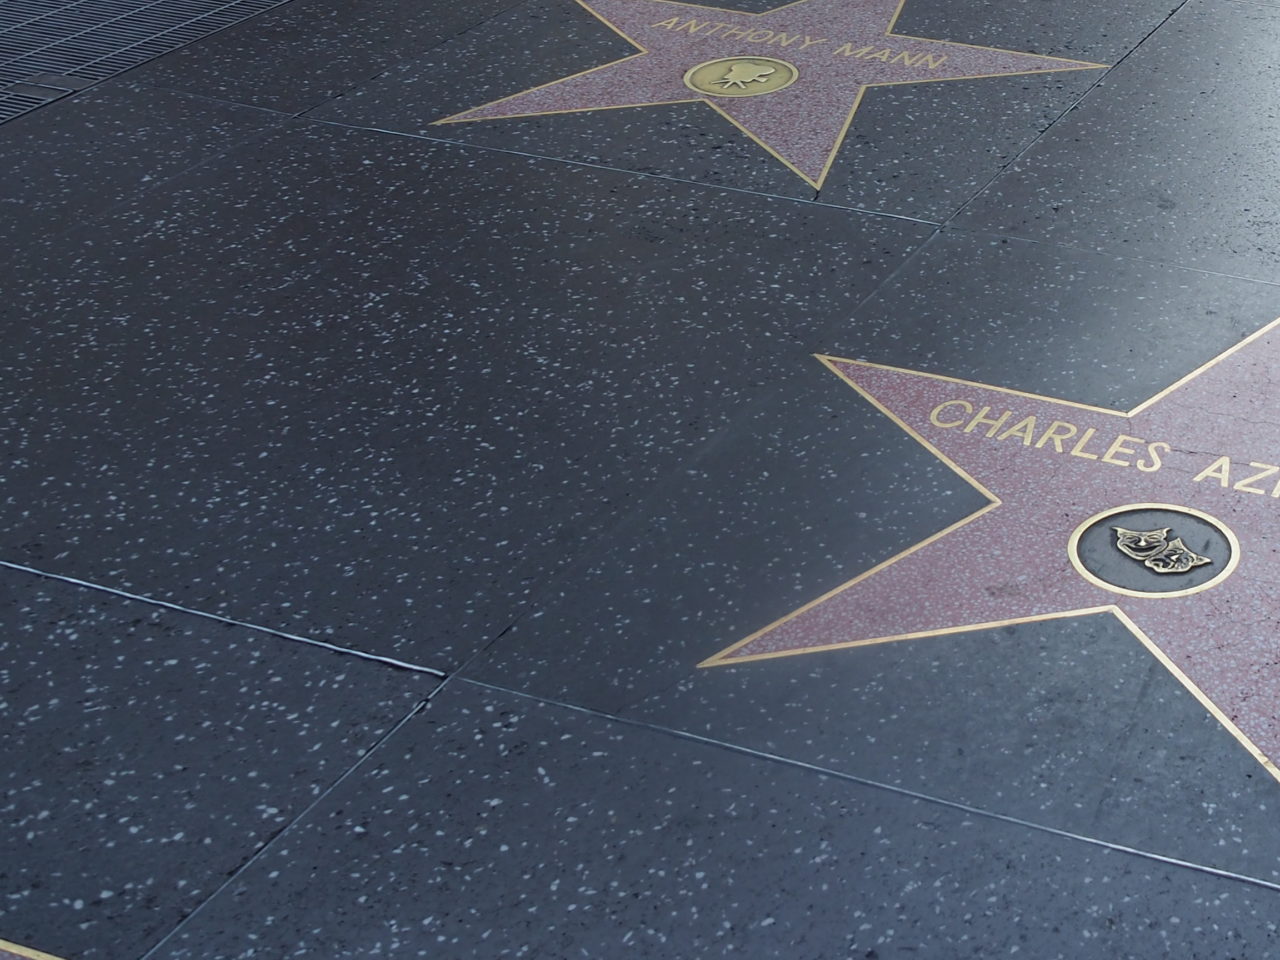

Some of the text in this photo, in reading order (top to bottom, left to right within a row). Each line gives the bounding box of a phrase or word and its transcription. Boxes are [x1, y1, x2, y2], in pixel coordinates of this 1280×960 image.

[651, 16, 949, 69] ANTHONY MANN
[929, 398, 1171, 474] CHARLES
